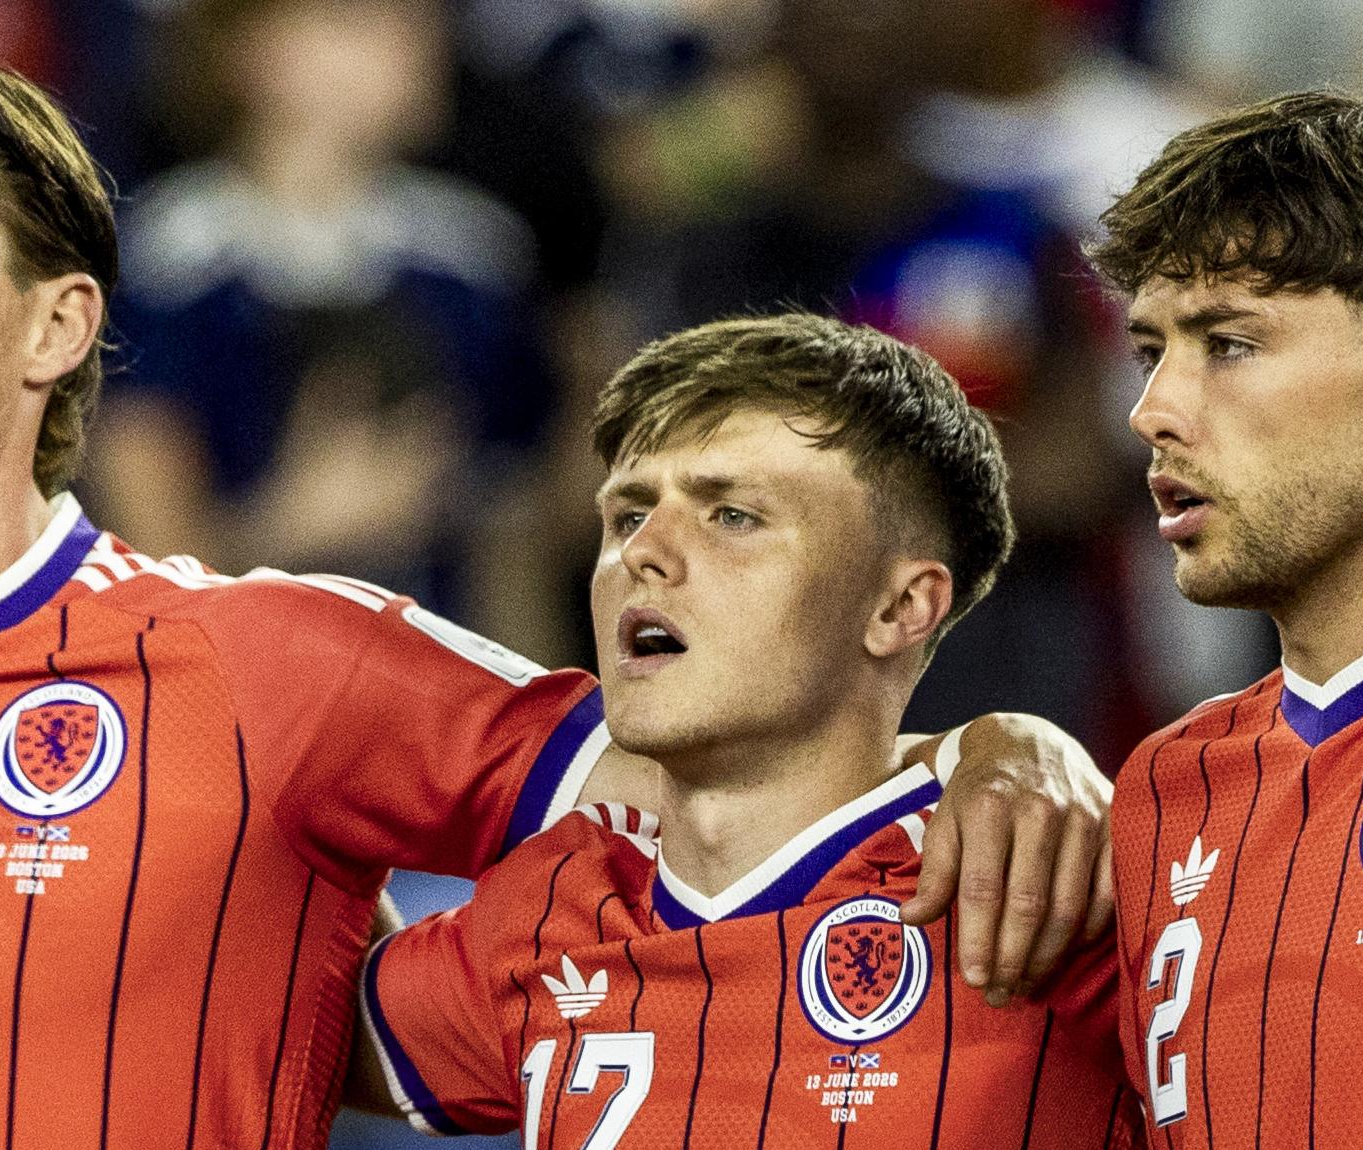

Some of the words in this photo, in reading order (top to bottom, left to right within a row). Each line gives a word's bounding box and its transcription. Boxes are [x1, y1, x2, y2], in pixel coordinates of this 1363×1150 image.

[836, 903, 897, 921] SCOTLAND
[816, 1009, 832, 1026] EST
[887, 1007, 908, 1025] 1873
[1145, 917, 1202, 1128] 2
[806, 1074, 821, 1089] 13
[823, 1072, 860, 1088] JUNE
[862, 1072, 899, 1087] 2026
[821, 1090, 875, 1105] BOSTON
[831, 1107, 857, 1123] USA
